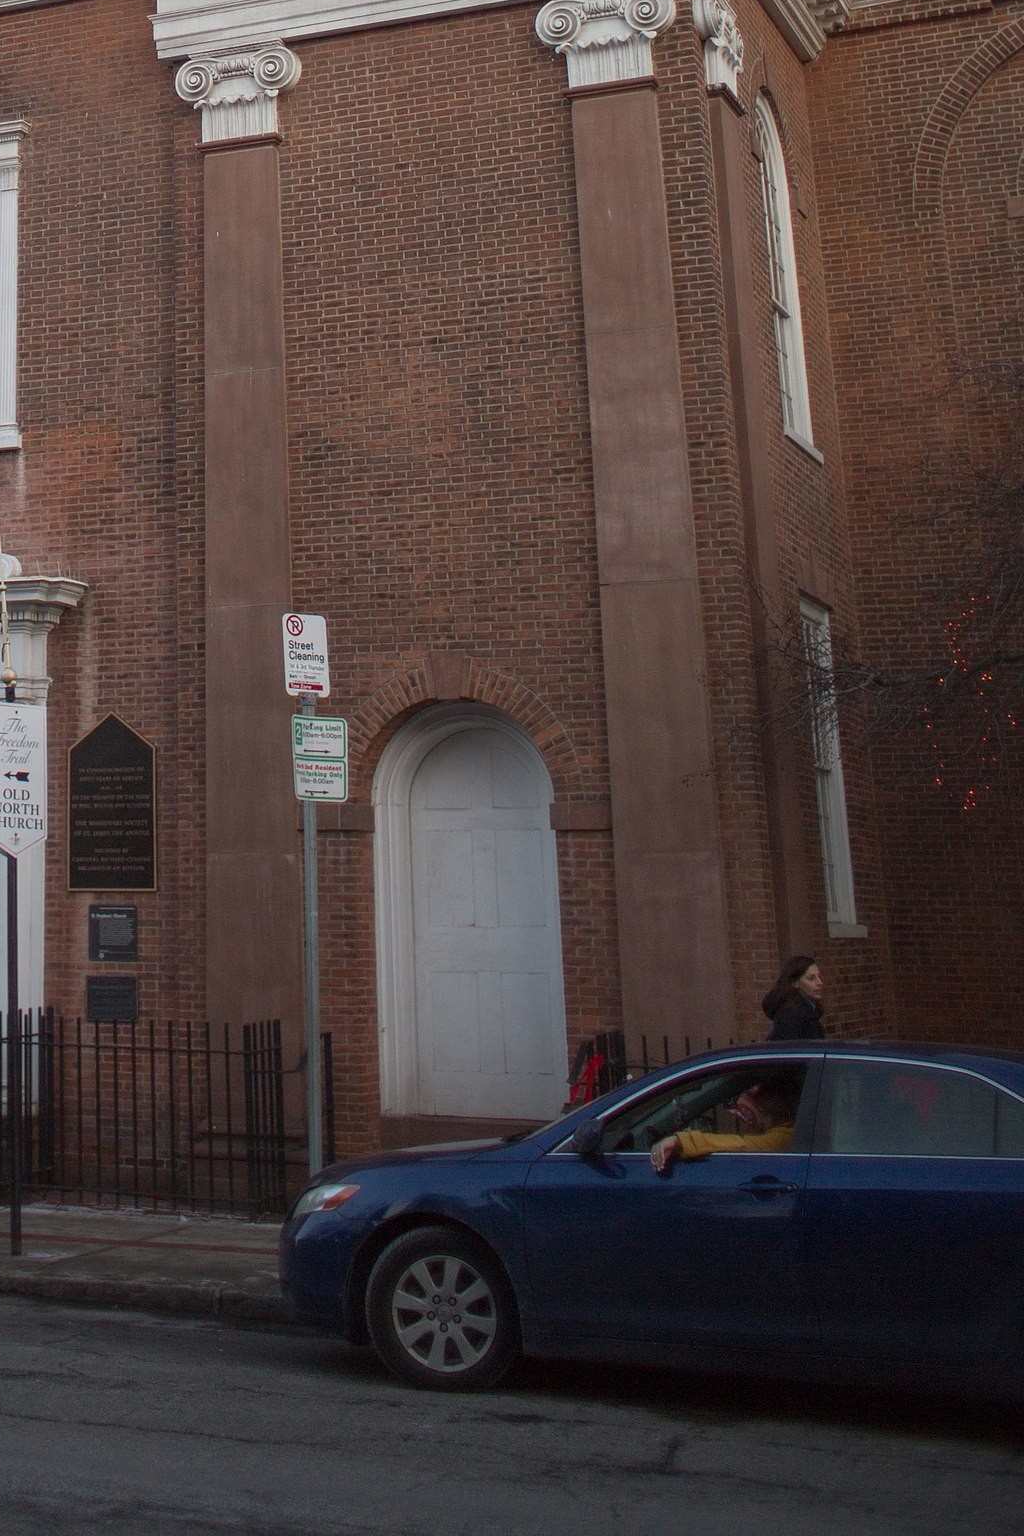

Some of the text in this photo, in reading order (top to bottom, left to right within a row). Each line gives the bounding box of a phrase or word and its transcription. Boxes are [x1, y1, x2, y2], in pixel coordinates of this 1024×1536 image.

[288, 639, 314, 651] Street
[288, 651, 325, 664] Cleaning
[2, 718, 27, 733] The
[295, 725, 302, 738] 2
[0, 749, 32, 765] Trail
[315, 764, 342, 772] Resident
[329, 771, 343, 780] Only
[2, 788, 30, 801] OLD
